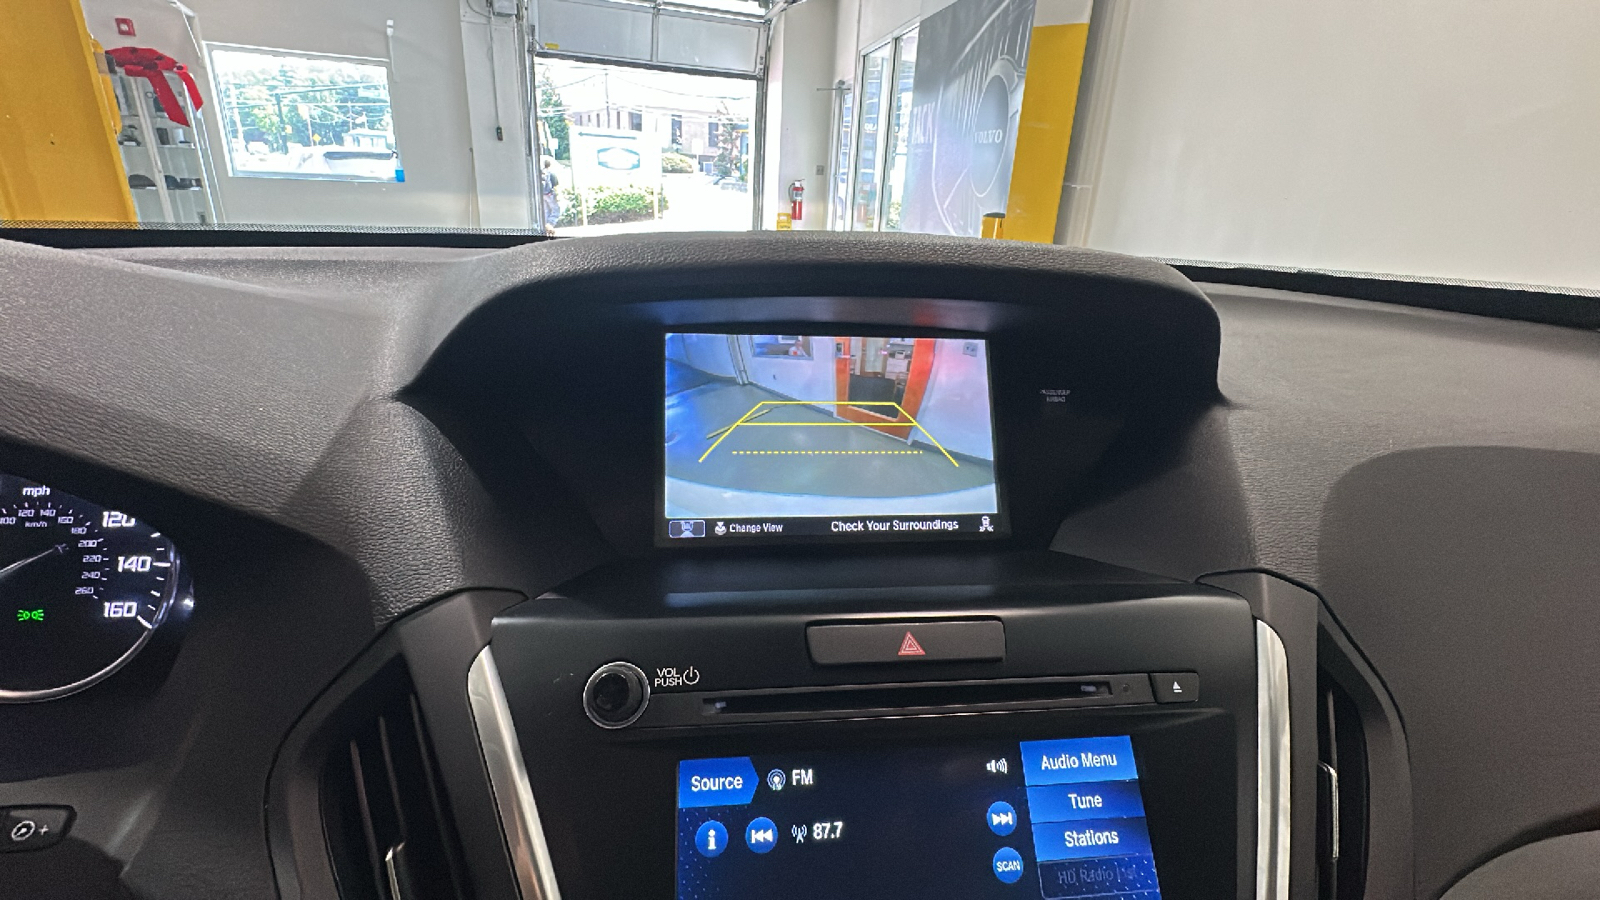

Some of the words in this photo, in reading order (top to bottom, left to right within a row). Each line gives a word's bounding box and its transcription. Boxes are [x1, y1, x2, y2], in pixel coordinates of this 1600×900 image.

[974, 128, 1003, 144] VOLVO
[22, 485, 51, 497] mph
[18, 509, 35, 517] 120
[40, 509, 56, 517] 140
[729, 523, 761, 534] Change
[763, 522, 784, 533] View
[831, 521, 864, 532] Check
[866, 520, 891, 531] Your
[892, 519, 959, 531] Surroundings
[78, 540, 98, 549] 200
[83, 555, 102, 563] 220
[117, 556, 152, 572] 140
[81, 571, 101, 579] 240
[75, 587, 94, 595] 260
[103, 602, 137, 618] 160
[656, 667, 681, 678] VOL
[654, 677, 682, 688] PUSH
[1041, 754, 1079, 771] Audio
[1081, 752, 1118, 768] Menu
[691, 775, 744, 792] Source
[791, 769, 814, 786] FM
[1067, 793, 1103, 809] Tune
[812, 821, 843, 840] 87.7
[1064, 829, 1119, 848] Stations
[996, 861, 1021, 873] SCAN
[1058, 869, 1076, 885] HD
[1079, 866, 1114, 883] Radio
